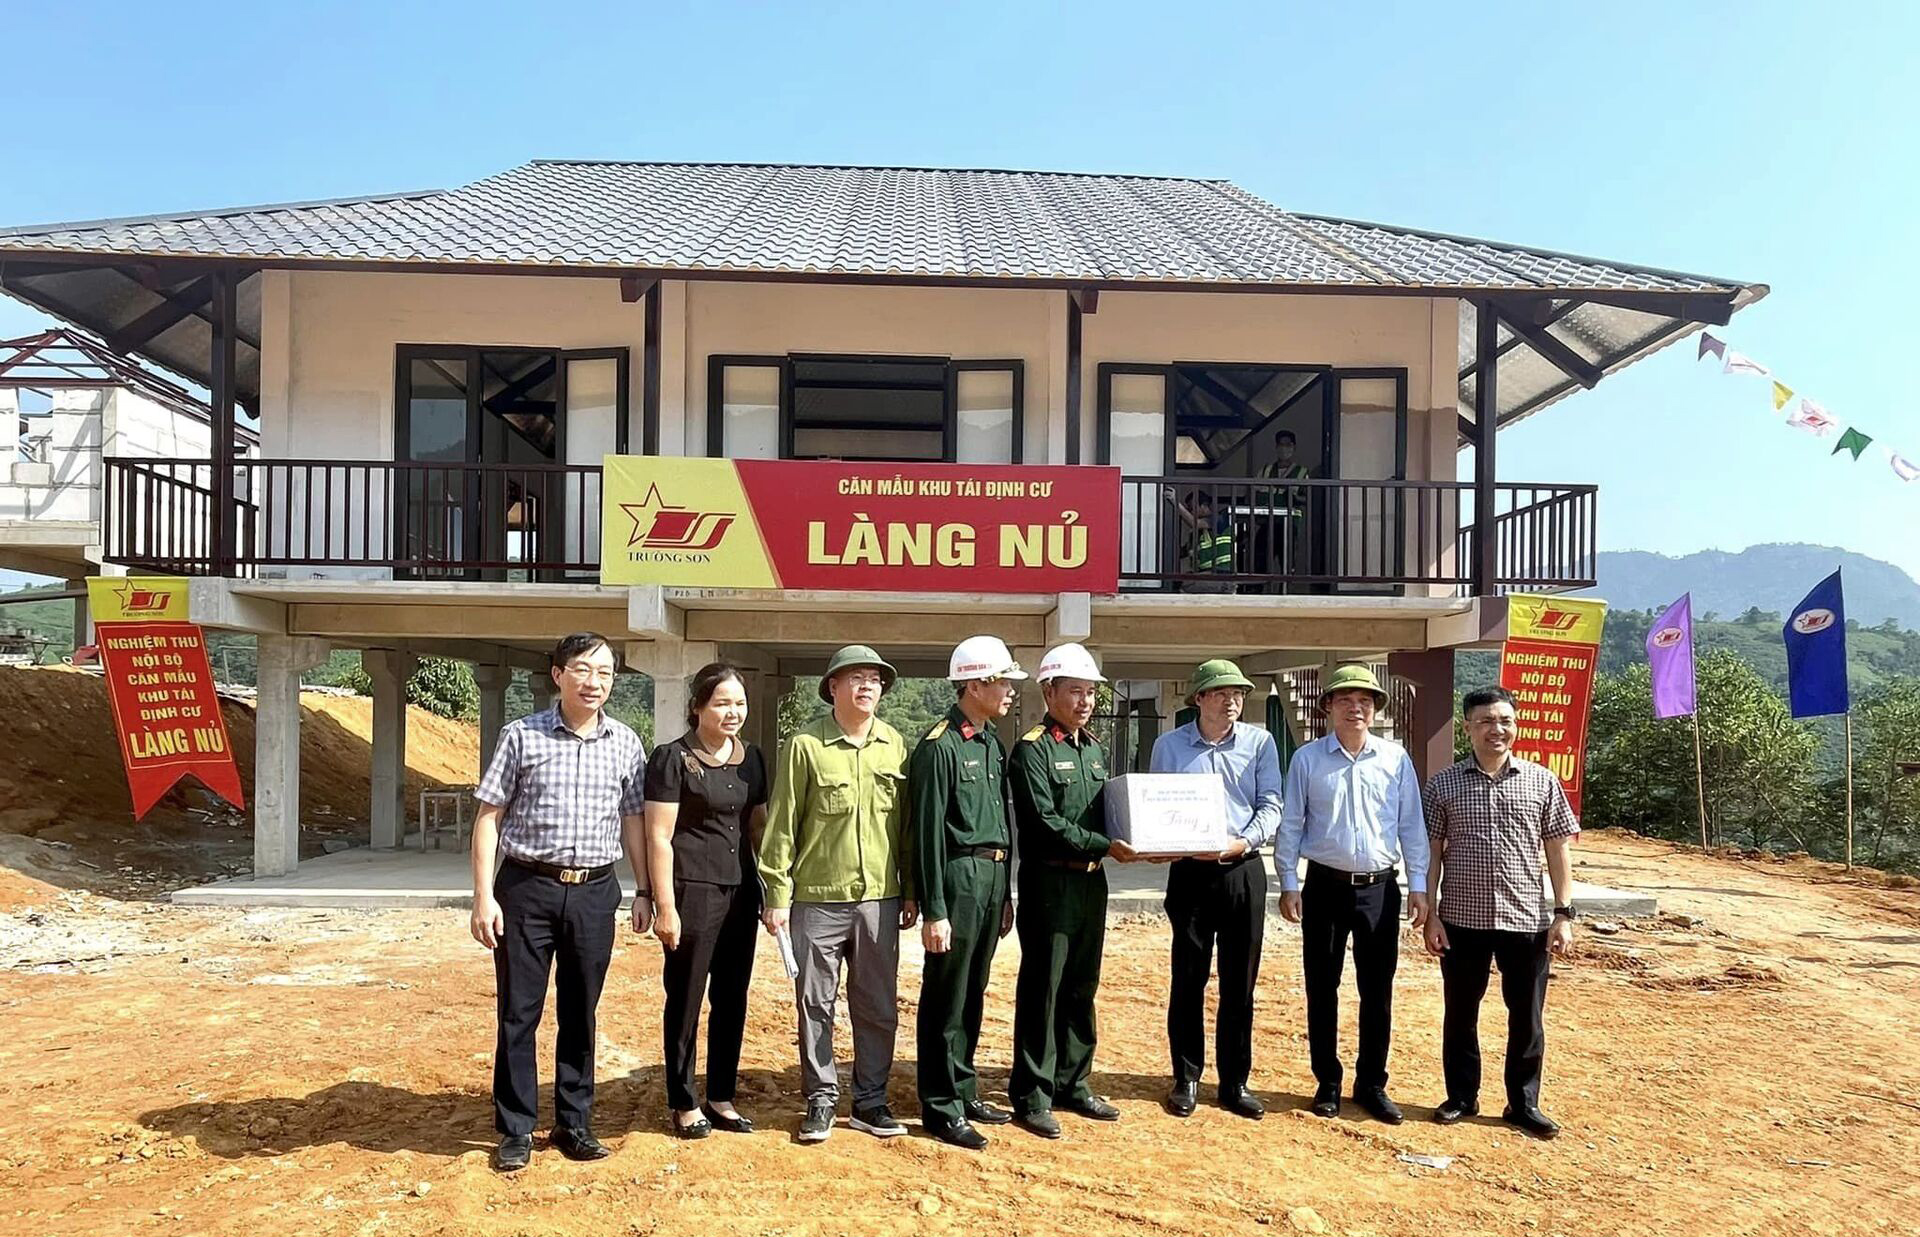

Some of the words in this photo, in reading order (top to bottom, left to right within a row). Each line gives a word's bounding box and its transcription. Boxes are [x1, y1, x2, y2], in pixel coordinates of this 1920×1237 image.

[838, 477, 872, 496] CĂN
[877, 474, 914, 496] MẪU
[918, 480, 951, 497] KHU
[956, 478, 981, 497] TÁI
[985, 480, 1025, 500] ĐỊNH
[1029, 480, 1053, 498] CƯ
[807, 512, 976, 568] LÀNG
[999, 510, 1088, 569] NỦ
[107, 635, 167, 650] NGHIỆM
[170, 636, 199, 649] THU
[133, 653, 161, 667] NỘI
[164, 652, 183, 667] BỘ
[1506, 652, 1558, 669] NGHIỆM
[1562, 656, 1587, 671] THU
[127, 671, 160, 685] CĂN
[165, 668, 197, 684] MẪU
[1520, 671, 1544, 687] NỘI
[1548, 672, 1566, 689] BỘ
[138, 689, 169, 703] KHU
[172, 687, 196, 702] TÁI
[1541, 687, 1572, 706] MẪU
[141, 705, 178, 723] ĐỊNH
[181, 704, 202, 719] CƯ
[1543, 708, 1564, 723] TÁI
[129, 725, 188, 760] LÀNG
[194, 720, 225, 754] NỦ
[1517, 726, 1541, 741] ỊNH
[1545, 729, 1565, 742] CƯ
[1548, 746, 1575, 782] NỦ
